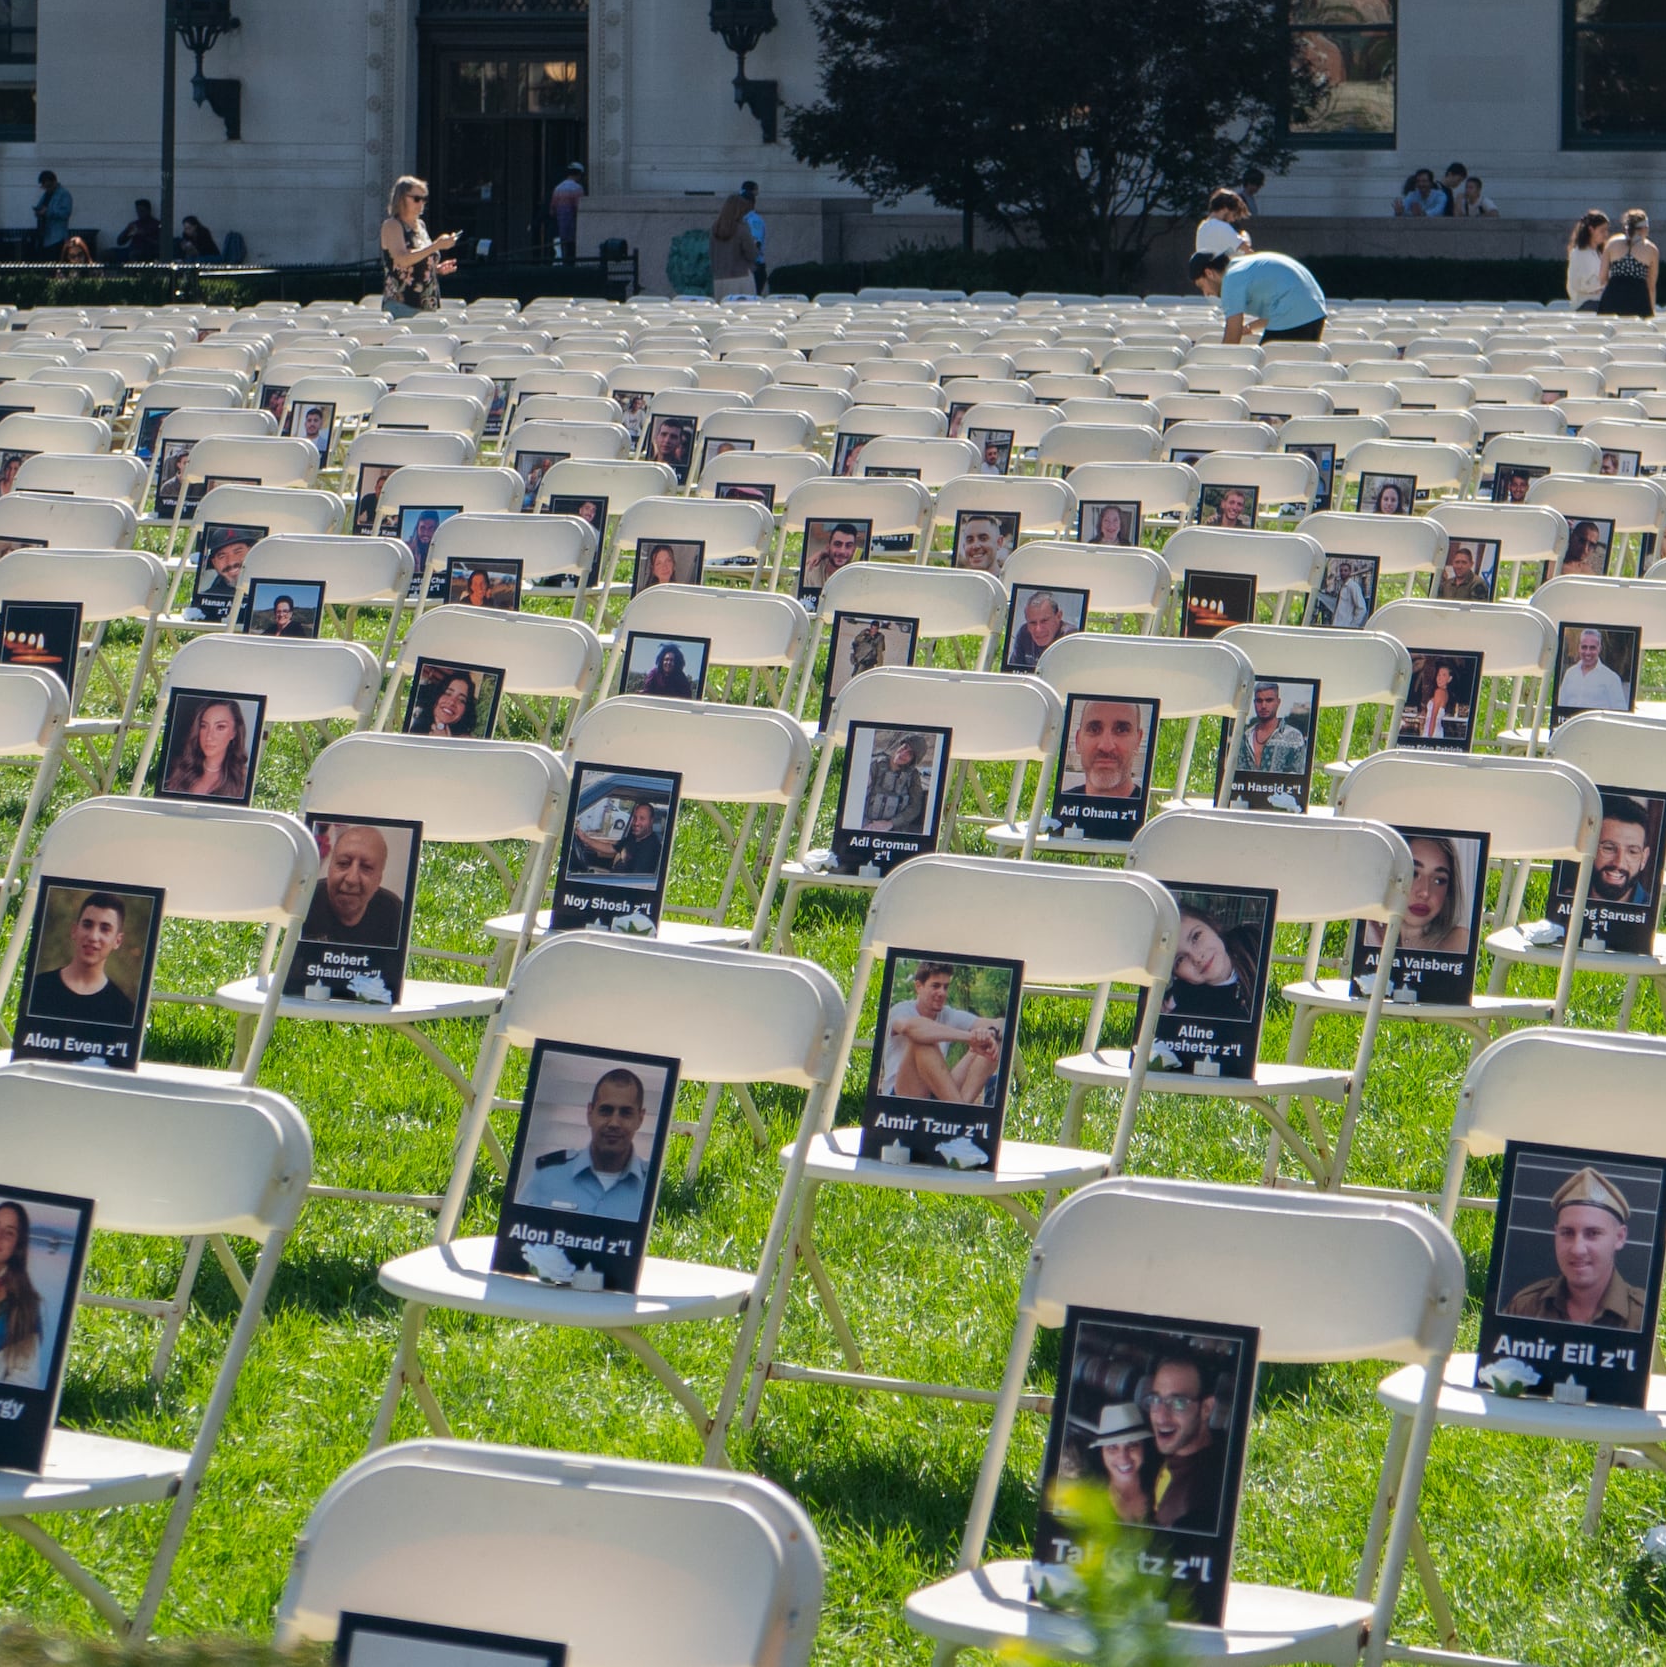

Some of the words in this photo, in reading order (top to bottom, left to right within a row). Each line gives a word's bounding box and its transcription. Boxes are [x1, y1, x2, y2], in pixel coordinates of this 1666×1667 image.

[1247, 781, 1284, 793] Hassid
[1286, 784, 1302, 795] z"l
[1060, 805, 1079, 817] Adi
[1082, 807, 1119, 820] Ohana
[1121, 809, 1137, 821] z"l
[850, 836, 870, 848] Adi
[872, 839, 920, 853] Groman
[874, 850, 891, 862] z"l
[563, 894, 589, 911] Noy
[591, 896, 631, 913] Shosh
[633, 902, 652, 915] z"l
[1557, 904, 1598, 921] Alog
[1599, 908, 1647, 924] Sarussi
[1591, 920, 1609, 932] z"l
[323, 951, 370, 968] Robert
[1403, 957, 1464, 976] Vaisberg
[1402, 971, 1423, 984] z"l
[1177, 1024, 1214, 1040] Aline
[23, 1032, 61, 1051] Alon
[64, 1037, 103, 1055] Even
[106, 1041, 129, 1058] z"l
[1221, 1042, 1242, 1057] z"l
[874, 1111, 918, 1131] Amir
[922, 1116, 962, 1136] Tzur
[964, 1122, 990, 1140] z"l
[508, 1222, 551, 1243] Alon
[553, 1228, 605, 1252] Barad
[607, 1238, 632, 1257] z"l
[1493, 1334, 1557, 1362] Amir
[1561, 1342, 1595, 1367] Eil
[1600, 1348, 1636, 1372] z"l
[1170, 1556, 1214, 1584] z"l
